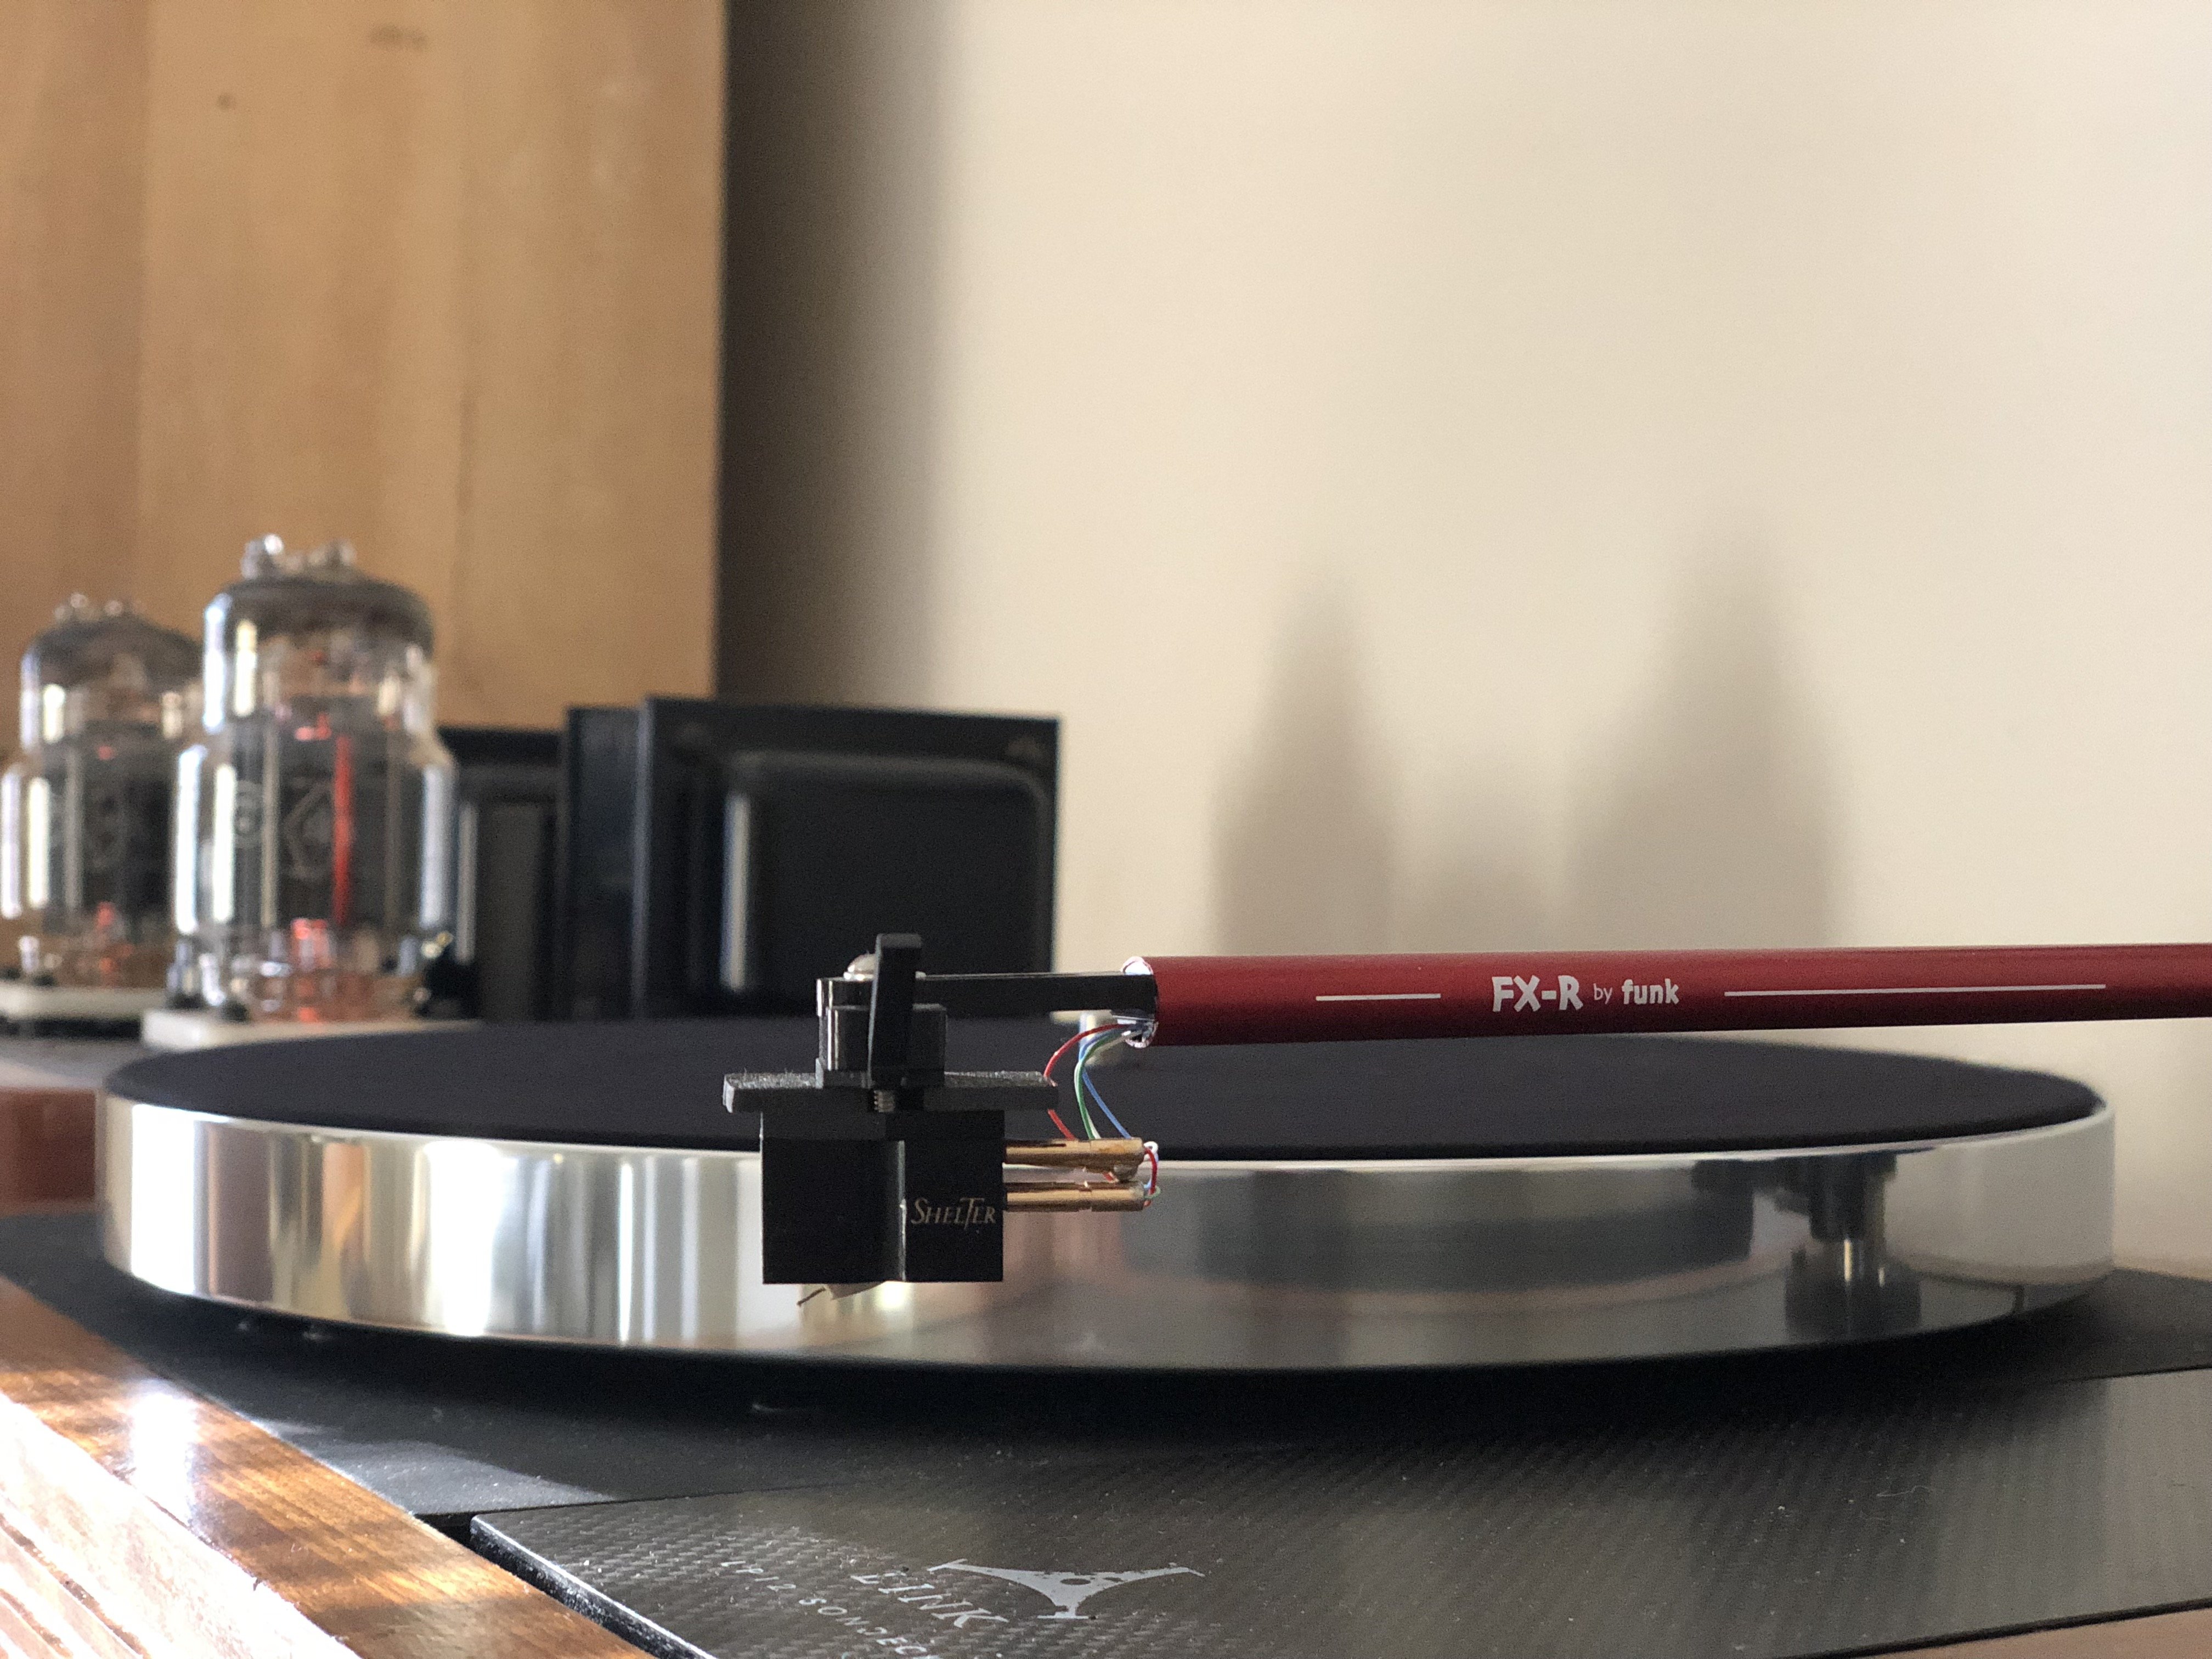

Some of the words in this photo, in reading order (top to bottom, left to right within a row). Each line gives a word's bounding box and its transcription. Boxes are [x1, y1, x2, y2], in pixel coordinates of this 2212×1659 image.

[1491, 974, 1583, 1012] FX-R
[1593, 983, 1613, 1004] by
[1622, 978, 1680, 1005] funk
